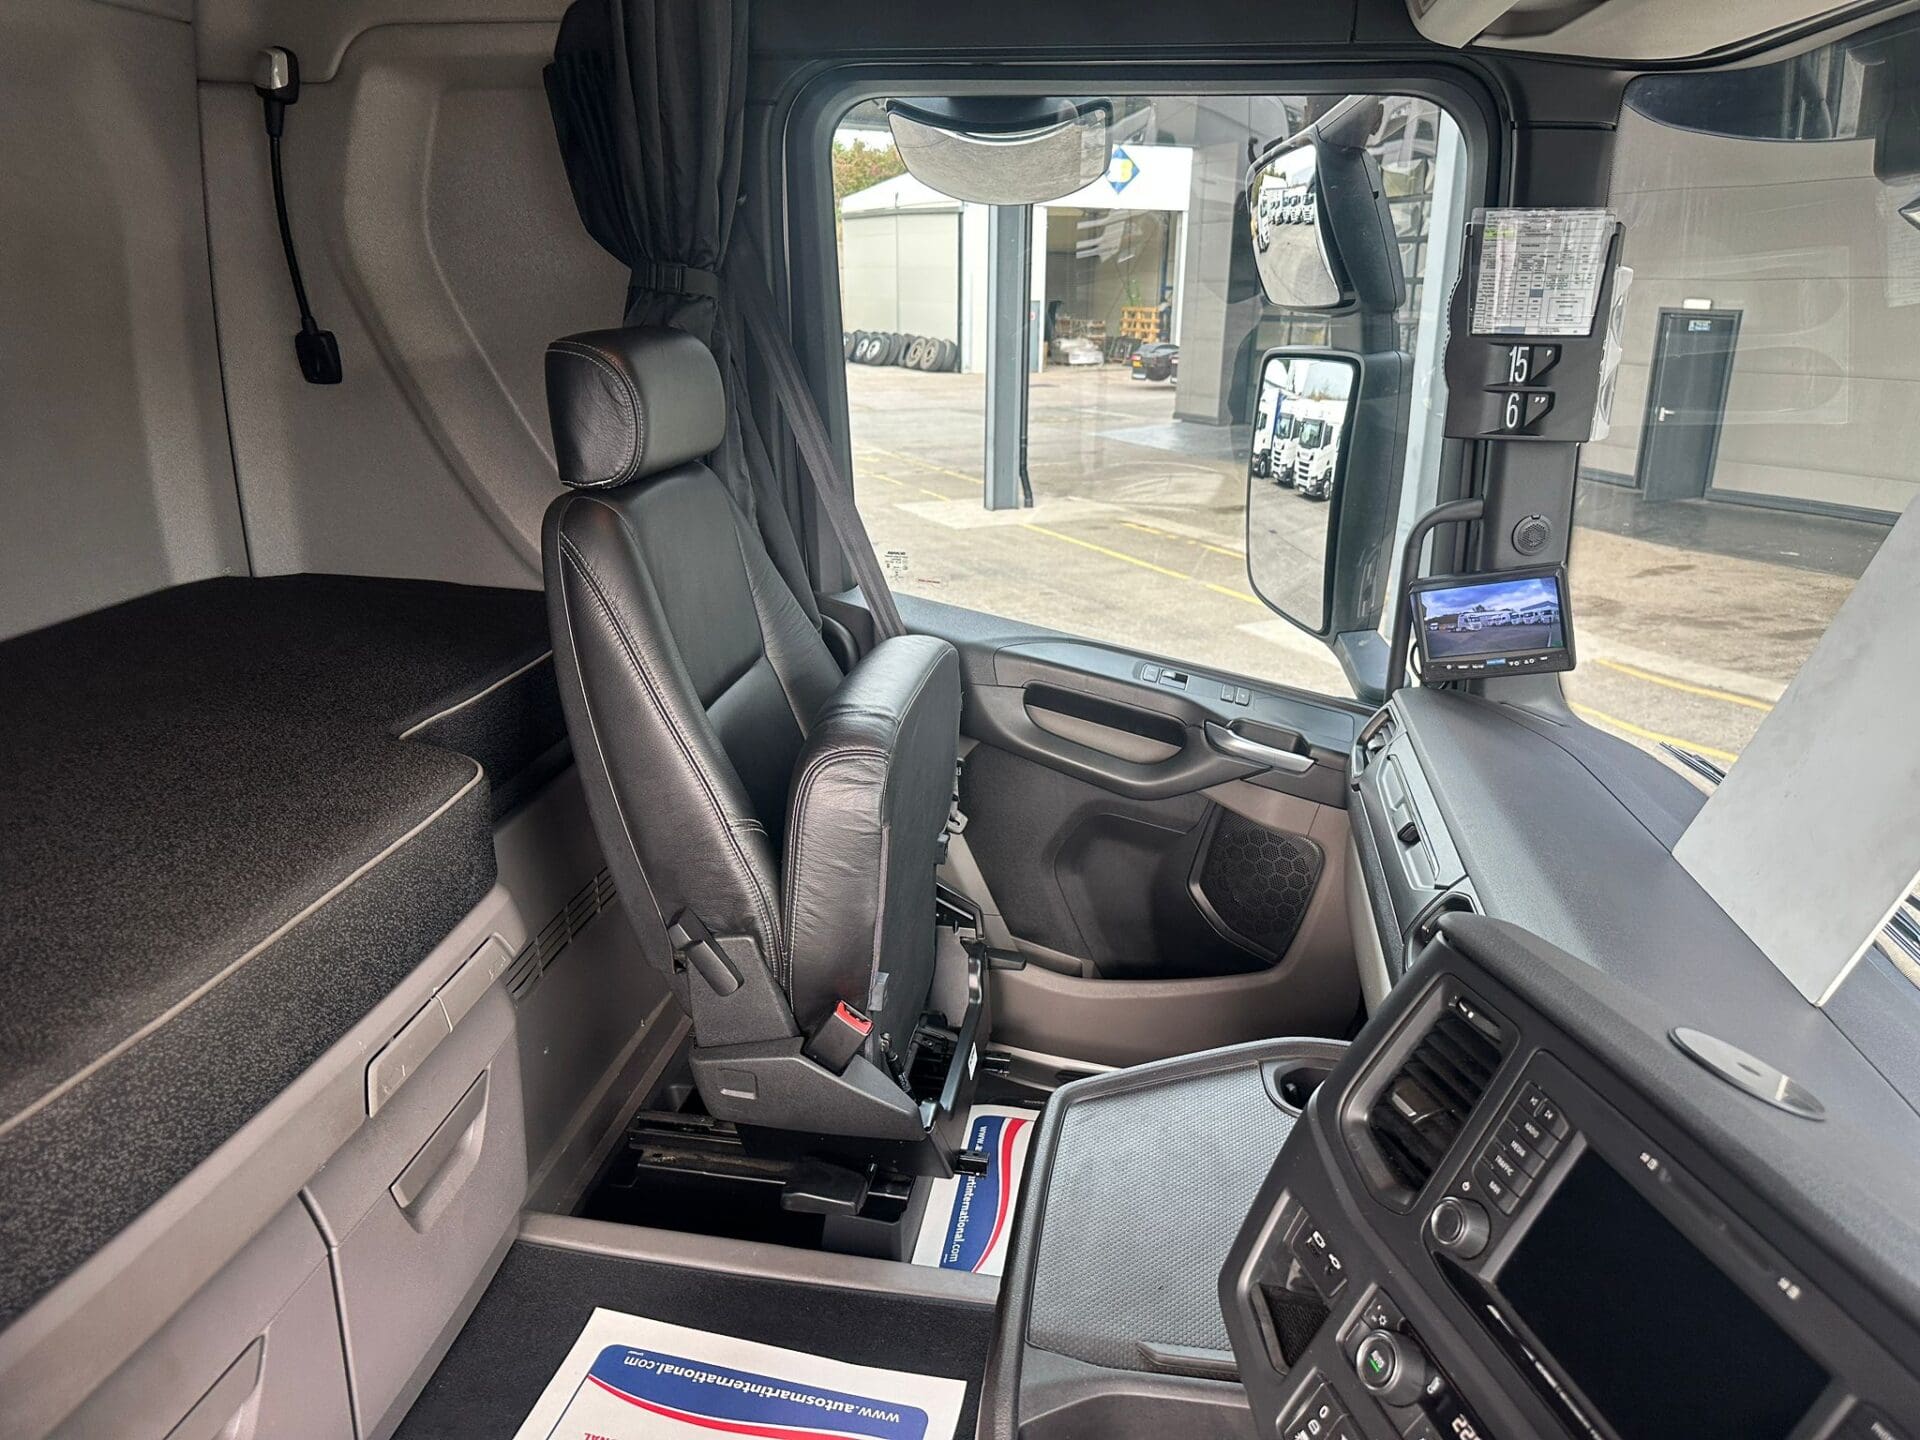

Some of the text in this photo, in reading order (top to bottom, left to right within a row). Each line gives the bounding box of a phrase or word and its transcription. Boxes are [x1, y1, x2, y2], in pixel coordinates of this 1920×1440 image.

[1508, 345, 1530, 383] 15
[1505, 393, 1520, 429] 6
[623, 1356, 901, 1424] www.autosmartinternational.com
